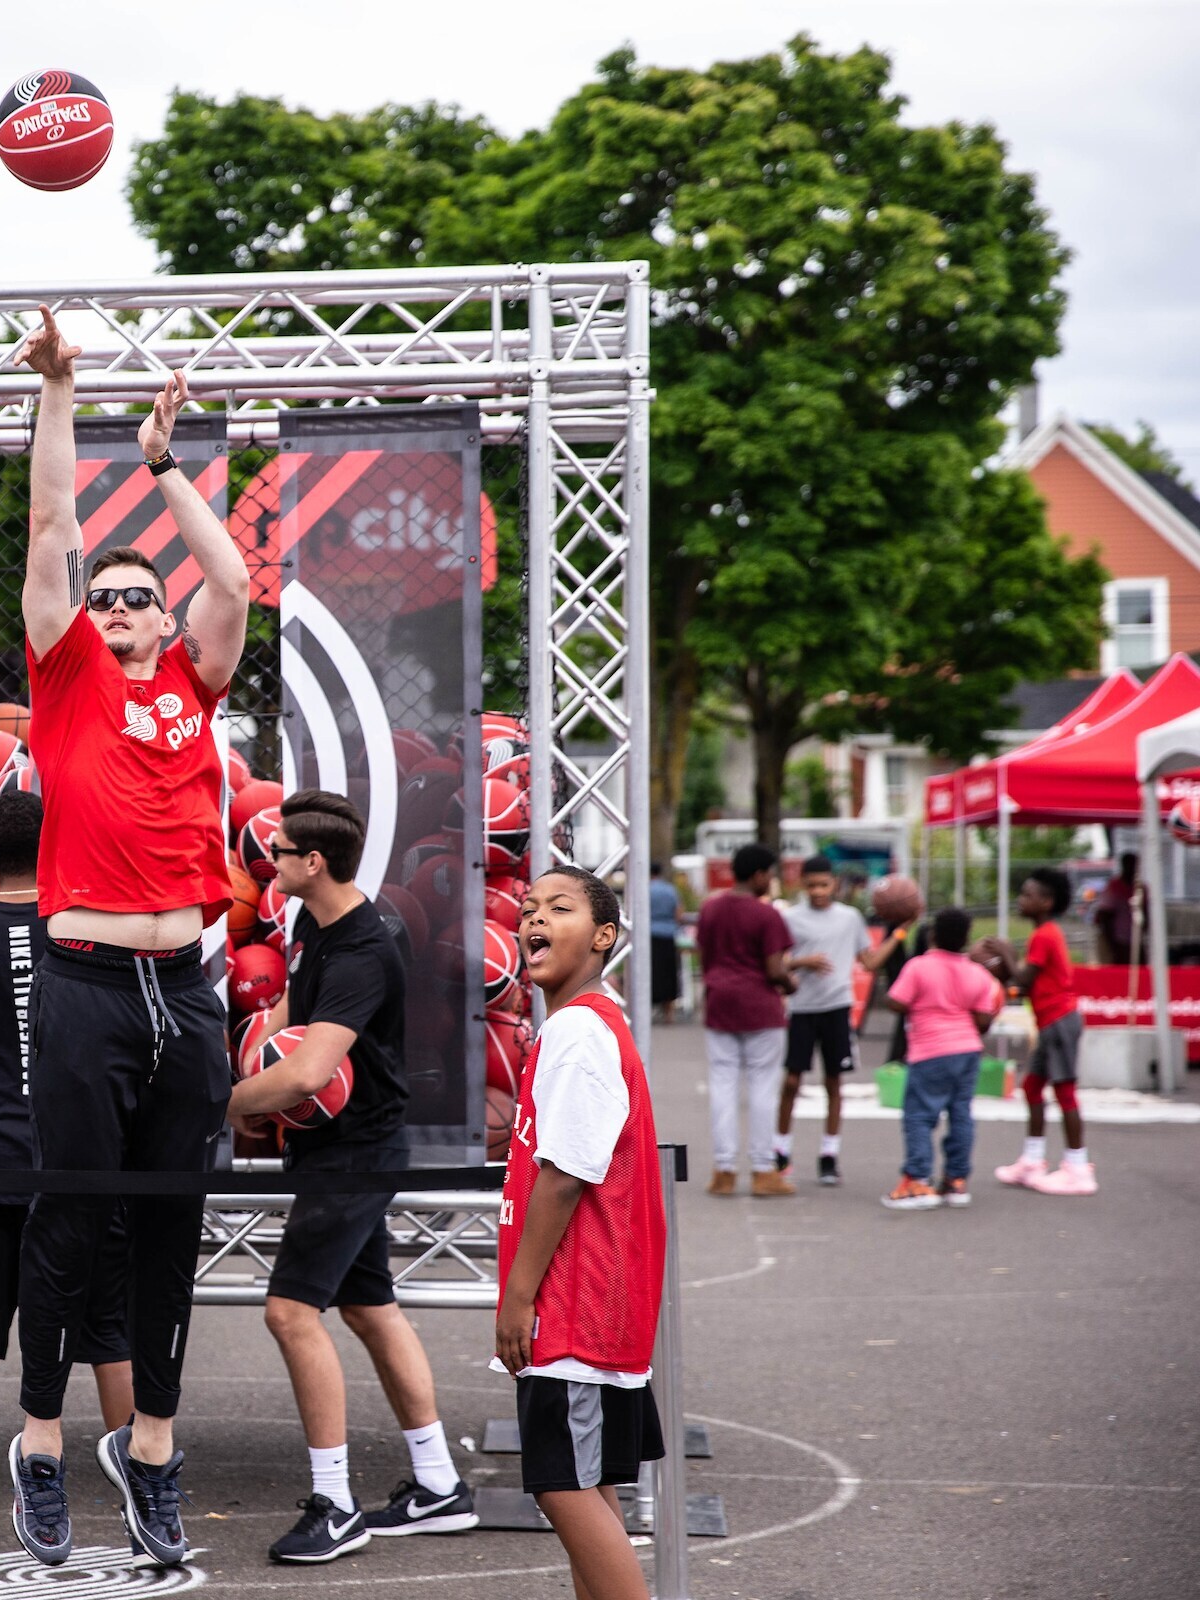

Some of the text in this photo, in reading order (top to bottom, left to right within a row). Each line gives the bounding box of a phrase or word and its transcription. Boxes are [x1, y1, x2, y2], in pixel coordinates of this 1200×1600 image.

[12, 102, 91, 140] SPALDING
[166, 711, 203, 750] play
[8, 925, 33, 970] NIKE
